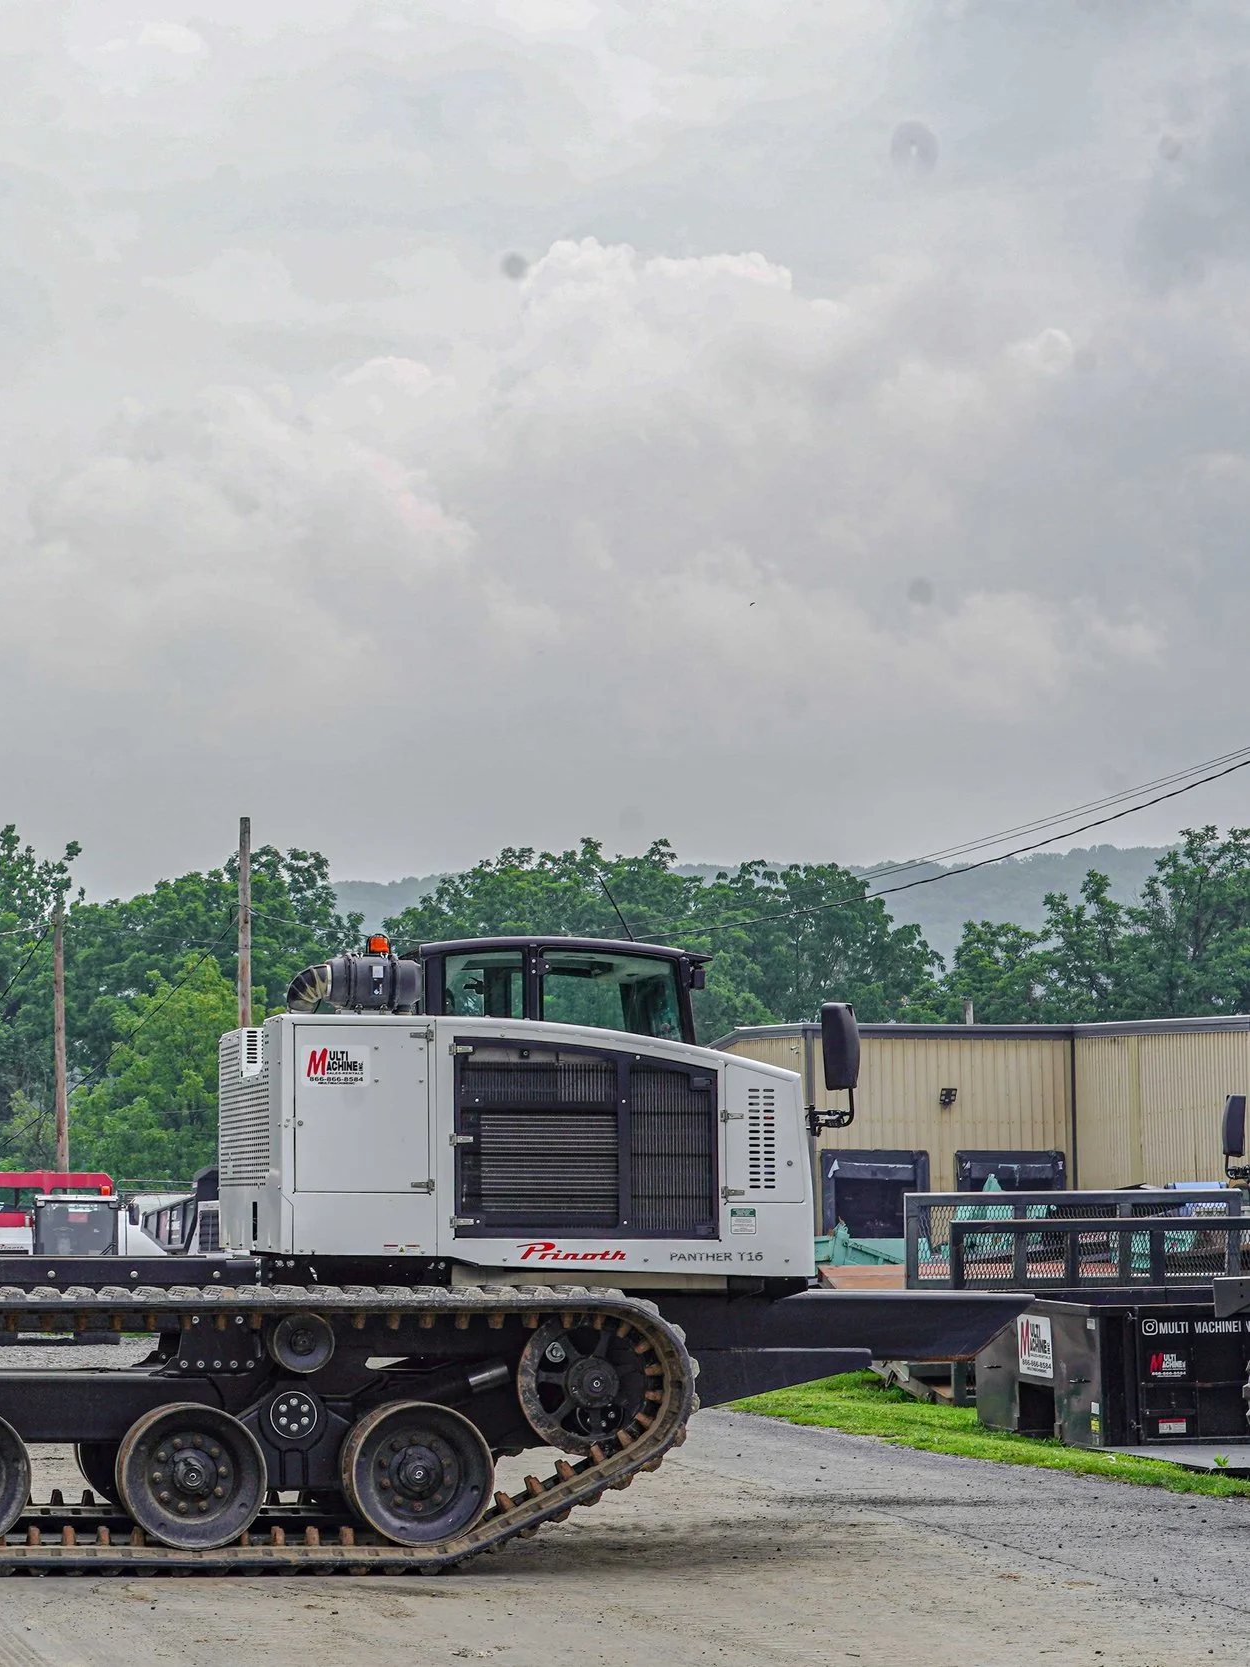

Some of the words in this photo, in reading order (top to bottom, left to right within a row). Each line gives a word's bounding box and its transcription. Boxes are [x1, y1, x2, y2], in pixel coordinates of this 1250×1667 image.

[517, 1242, 626, 1261] Prinoth
[670, 1252, 732, 1262] PANTHER
[738, 1252, 764, 1262] T16
[1159, 1321, 1189, 1334] MULTI
